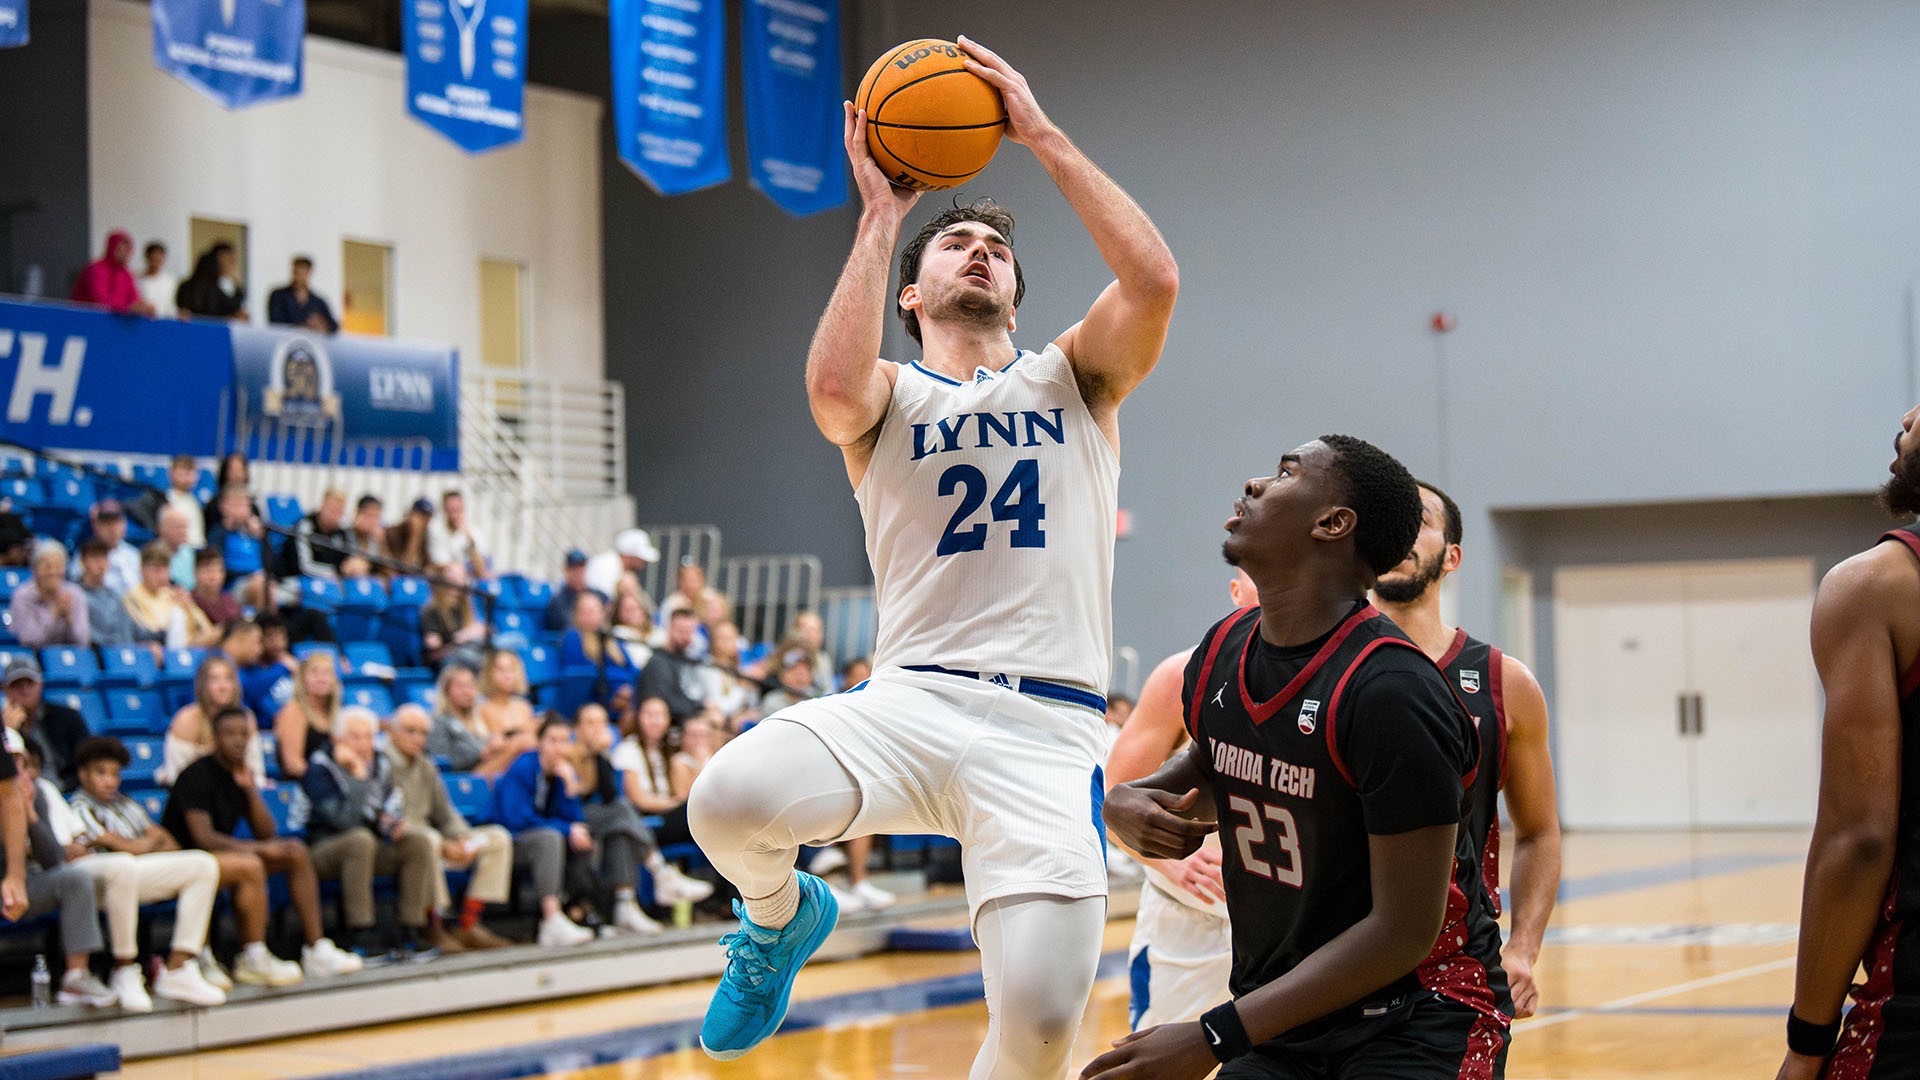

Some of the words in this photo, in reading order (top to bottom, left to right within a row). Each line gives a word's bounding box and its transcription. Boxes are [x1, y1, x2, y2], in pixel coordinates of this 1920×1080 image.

[910, 408, 1065, 461] LYNN
[936, 459, 1046, 558] 24
[1208, 736, 1264, 786] LORIDA
[1269, 757, 1316, 799] TECH
[1228, 792, 1304, 889] 23
